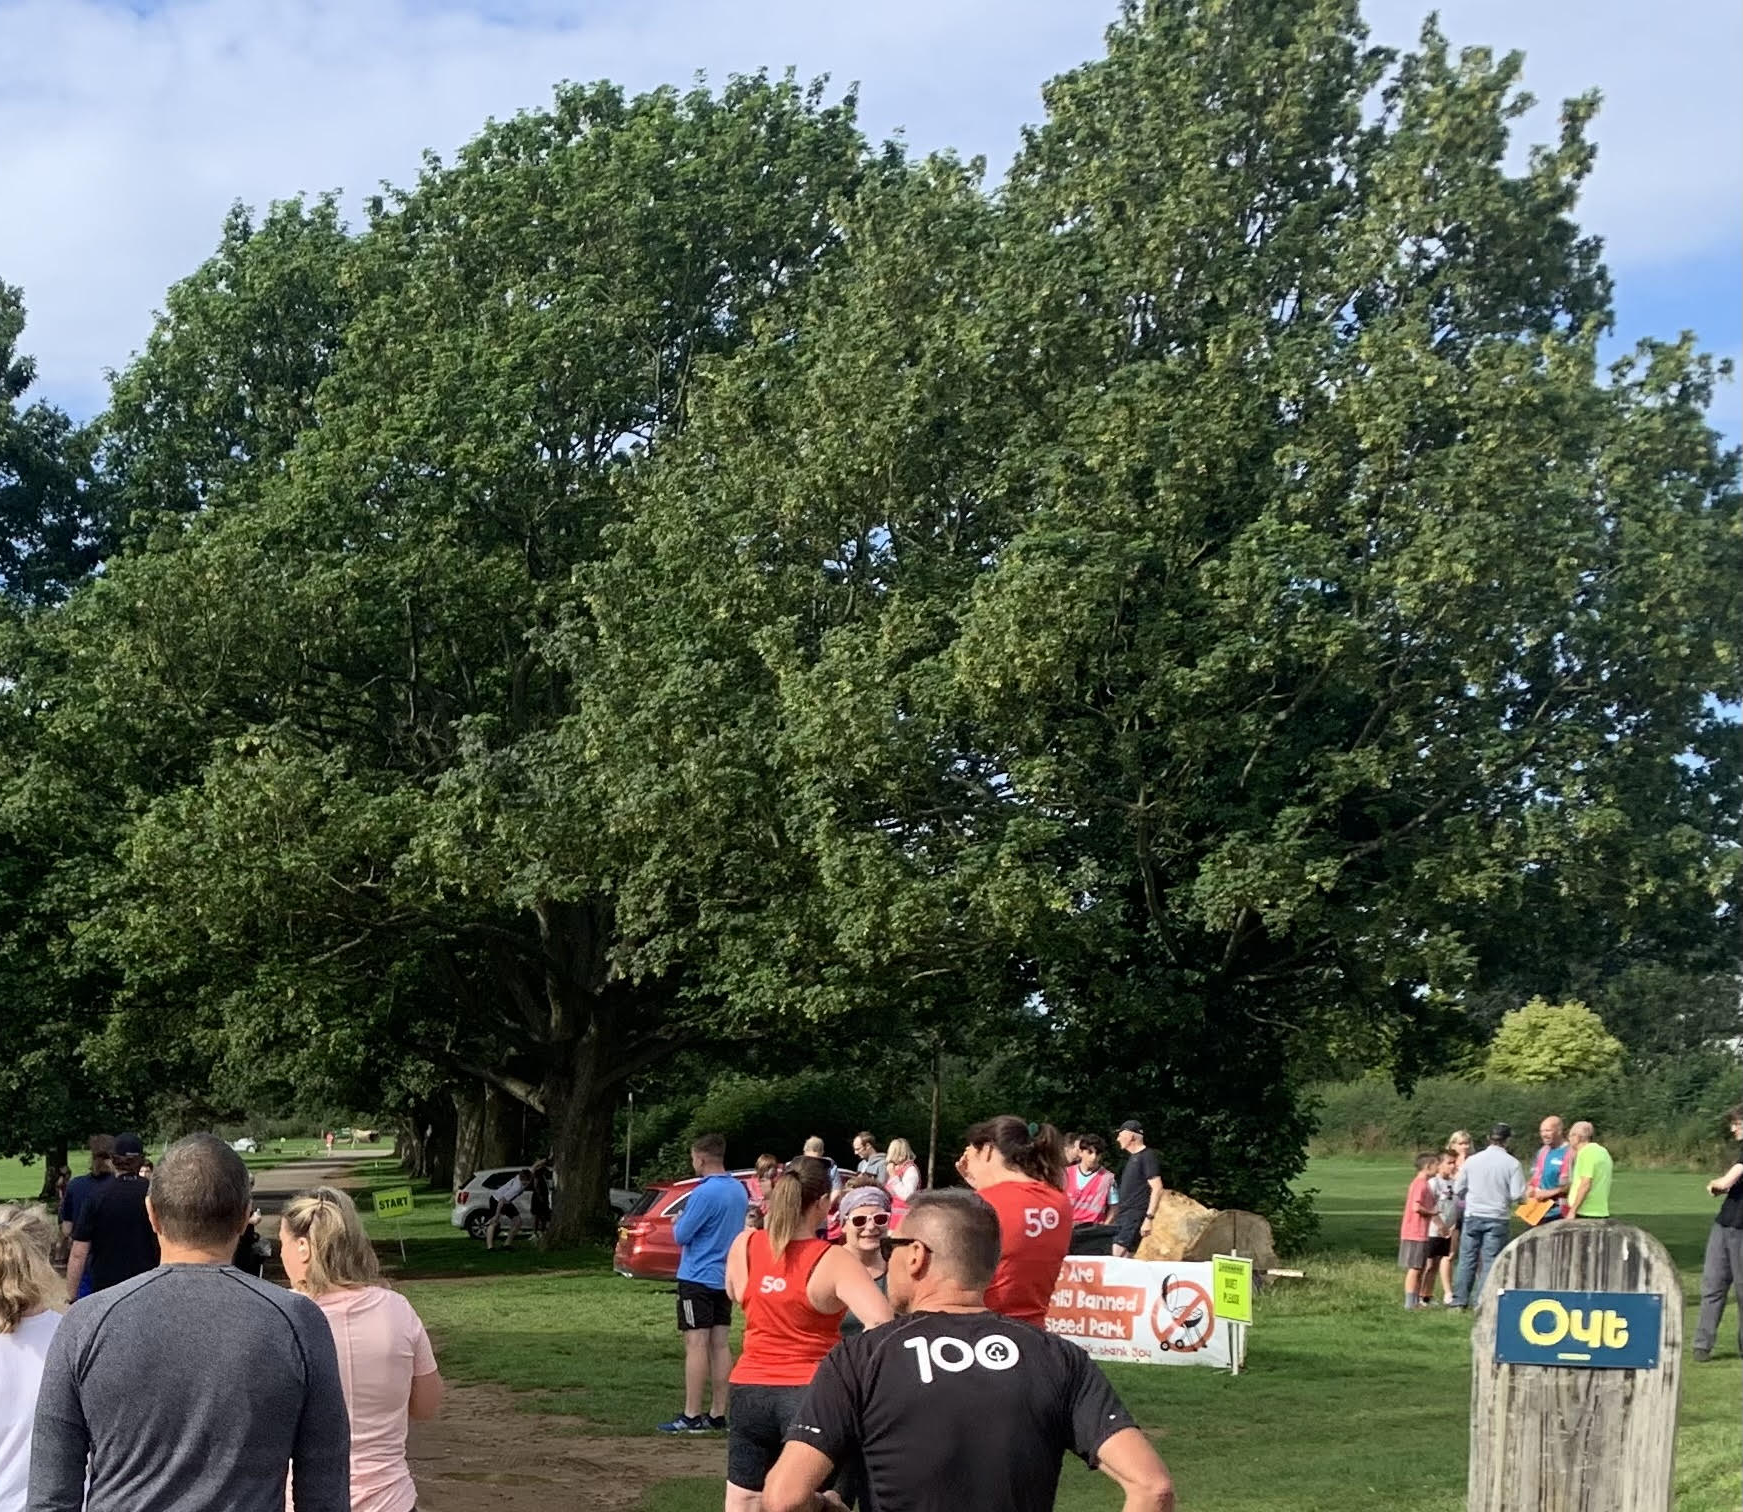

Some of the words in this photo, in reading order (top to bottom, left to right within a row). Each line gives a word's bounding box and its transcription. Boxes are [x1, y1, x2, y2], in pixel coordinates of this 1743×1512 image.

[378, 1197, 408, 1210] START
[1024, 1206, 1060, 1238] 50
[1067, 1263, 1095, 1283] Are
[760, 1275, 787, 1294] 50
[1076, 1288, 1138, 1312] Banned
[1089, 1317, 1126, 1338] Park
[1519, 1298, 1629, 1349] Out
[903, 1334, 1020, 1384] 100
